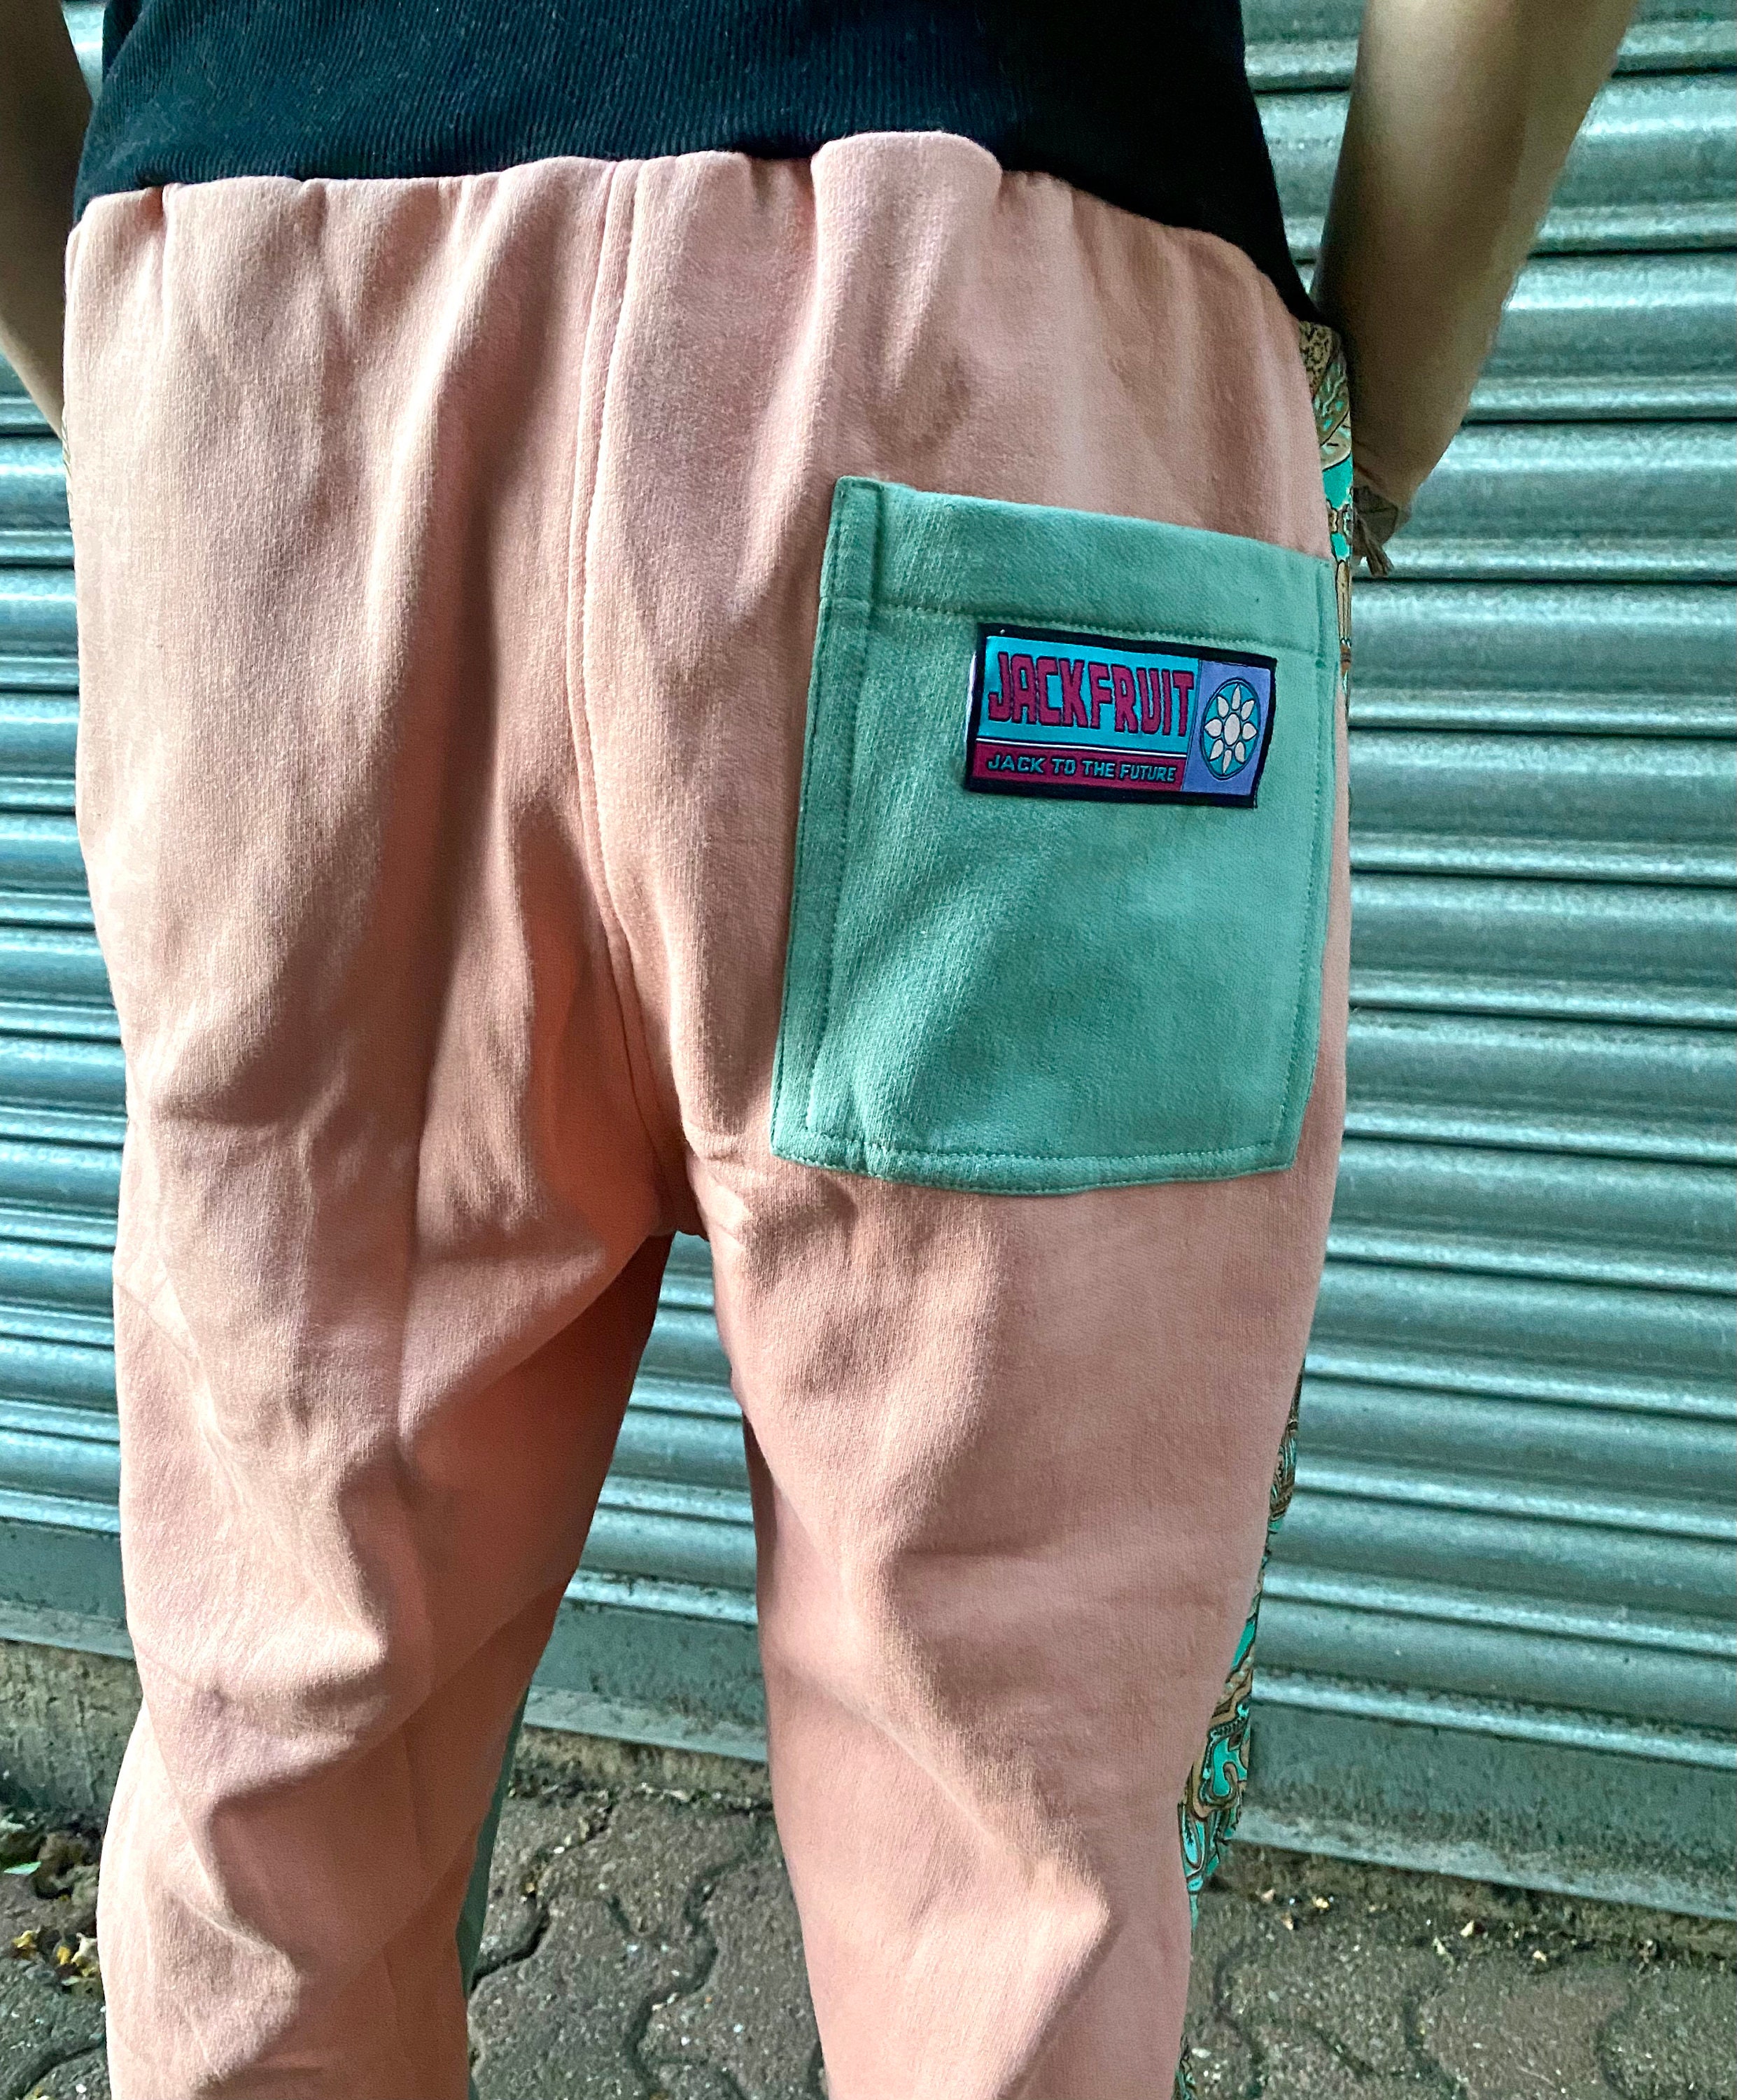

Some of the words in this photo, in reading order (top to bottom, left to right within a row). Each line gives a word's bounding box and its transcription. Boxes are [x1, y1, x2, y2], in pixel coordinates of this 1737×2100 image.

[987, 651, 1195, 737] JACKFRUIT
[987, 754, 1046, 774] JACK
[1051, 758, 1076, 775] TO
[1082, 760, 1116, 778] THE
[1119, 763, 1177, 783] FUTURE
